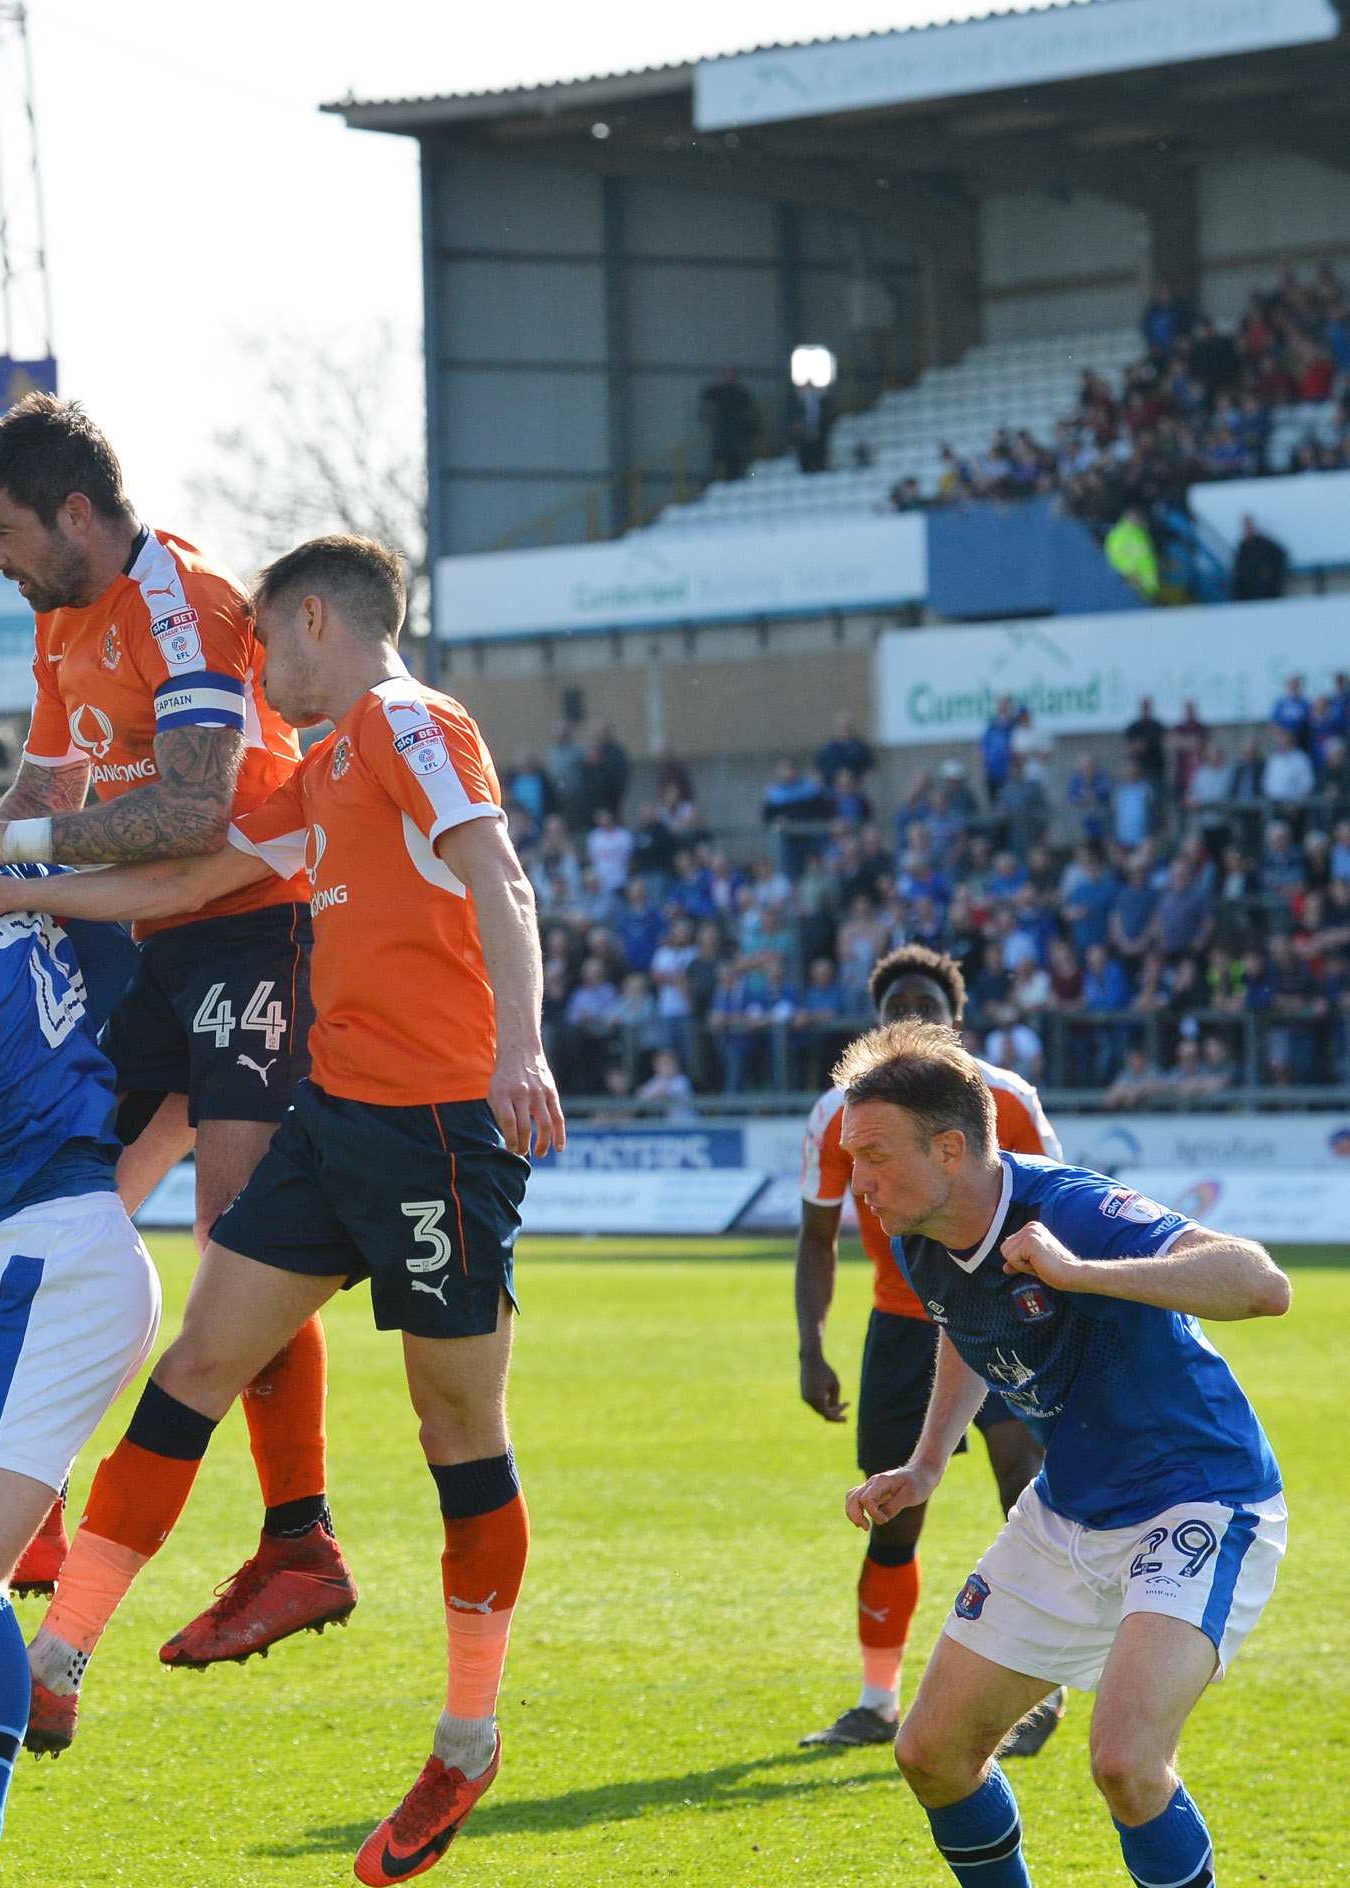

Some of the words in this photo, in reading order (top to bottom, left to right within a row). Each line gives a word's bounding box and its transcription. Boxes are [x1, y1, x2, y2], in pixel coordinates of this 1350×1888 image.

[173, 612, 193, 625] BET
[159, 628, 178, 640] LEAGUE
[176, 651, 190, 660] EFL
[156, 694, 192, 713] CAPTAIN
[419, 728, 438, 739] BET
[405, 742, 425, 755] LEAGUE
[424, 761, 438, 771] EFL
[193, 981, 287, 1050] 44
[401, 1200, 451, 1273] 3
[1130, 1519, 1218, 1580] 29
